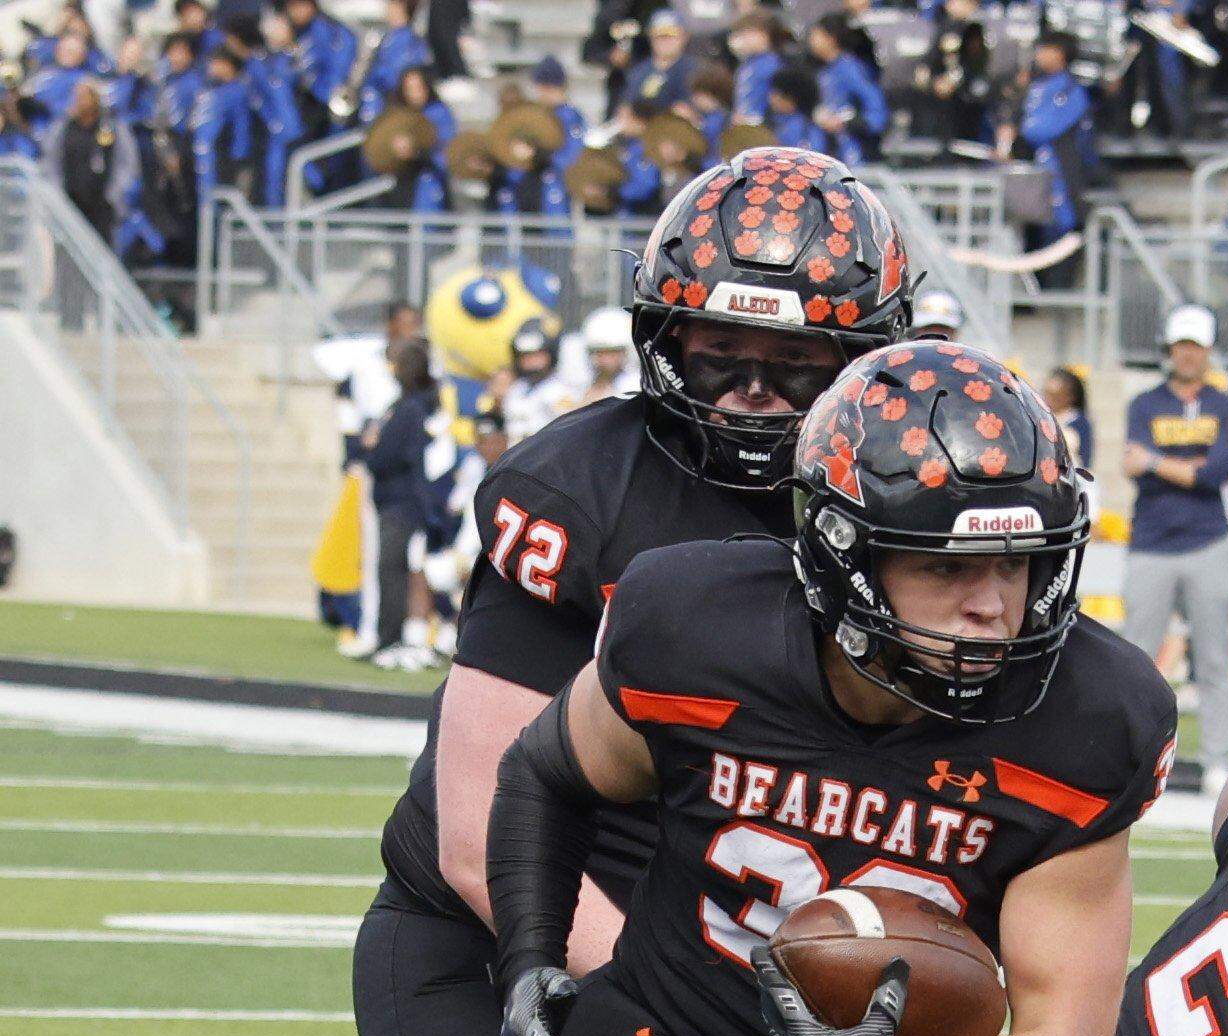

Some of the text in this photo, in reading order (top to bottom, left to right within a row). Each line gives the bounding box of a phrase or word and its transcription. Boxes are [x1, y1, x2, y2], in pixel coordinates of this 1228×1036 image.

[726, 294, 780, 315] ALEDO
[968, 515, 1035, 533] Riddell
[488, 498, 569, 604] 72
[947, 686, 984, 699] Rddell
[709, 752, 995, 865] BEARCATS
